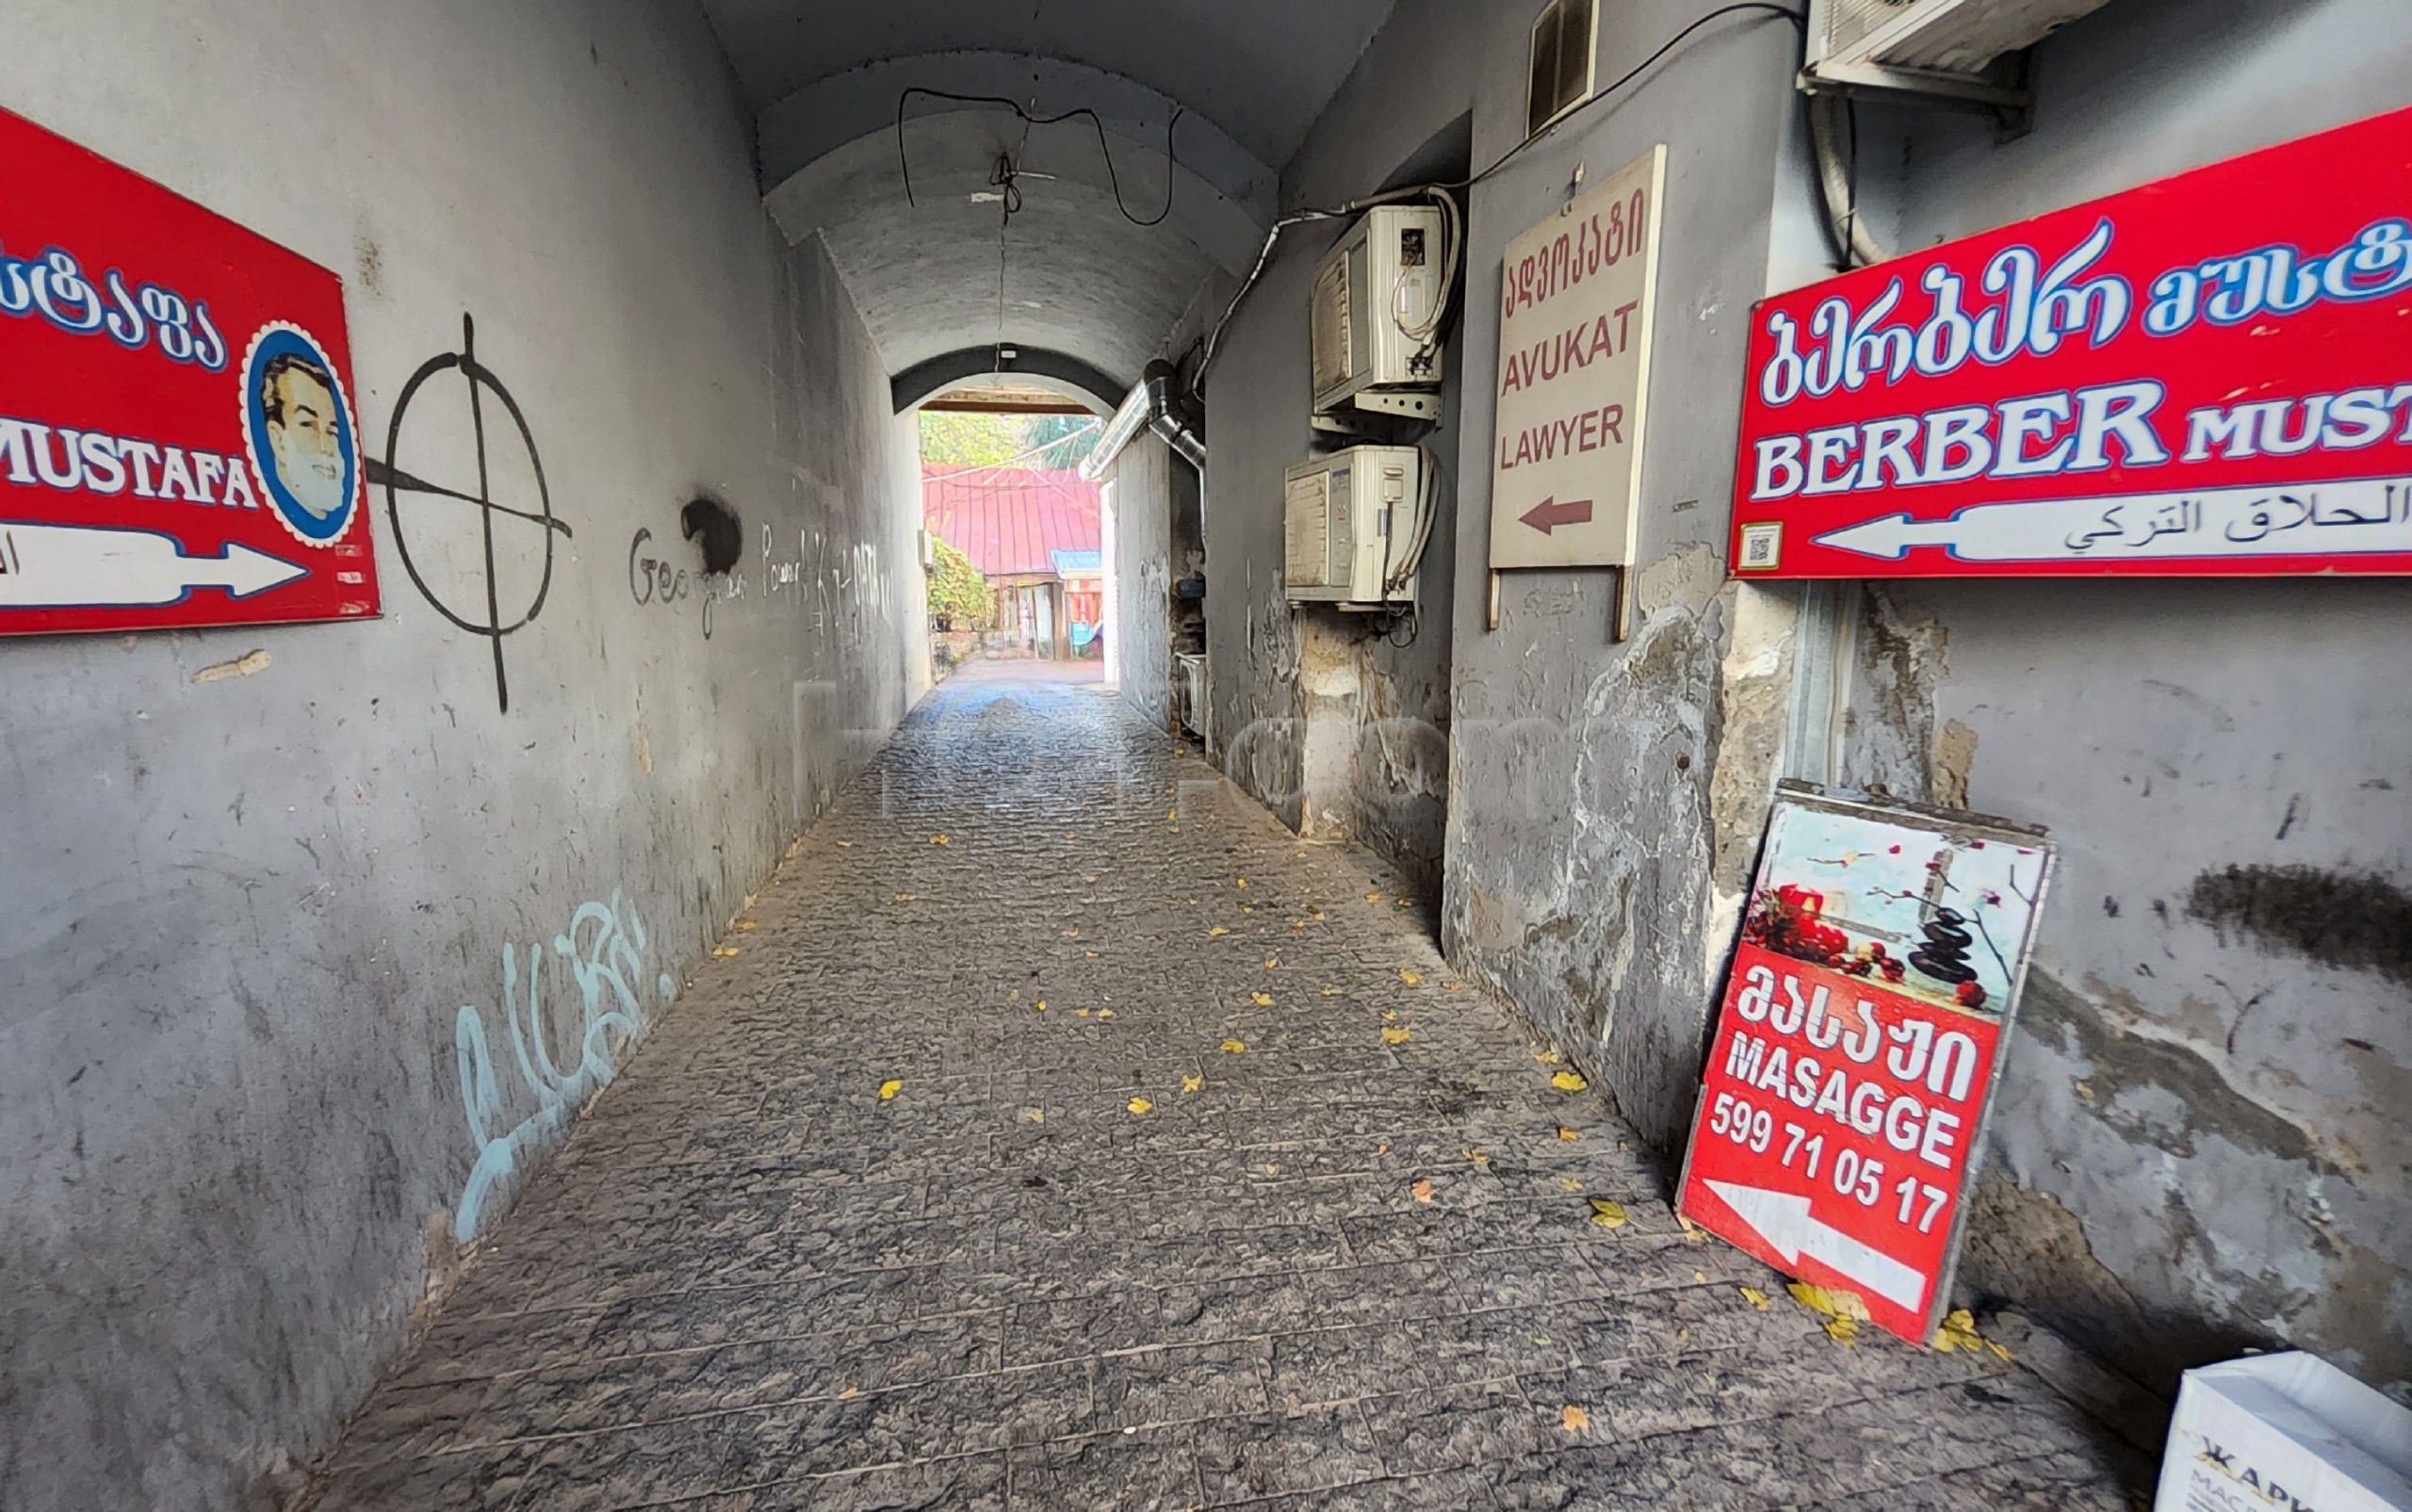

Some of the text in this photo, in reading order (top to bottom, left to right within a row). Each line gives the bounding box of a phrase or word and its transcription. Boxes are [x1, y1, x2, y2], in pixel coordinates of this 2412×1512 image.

[1506, 187, 1644, 319] ადვოკატი
[1762, 219, 2130, 404] ბერბერ
[1501, 300, 1639, 397] AVUKAT
[1500, 403, 1623, 470] LAWYER
[1750, 379, 2170, 501] BERBER
[1725, 1031, 1961, 1169] MASAGGE
[1736, 965, 1977, 1102] მასაჟი
[1710, 1093, 1948, 1235] 599 71 05 17
